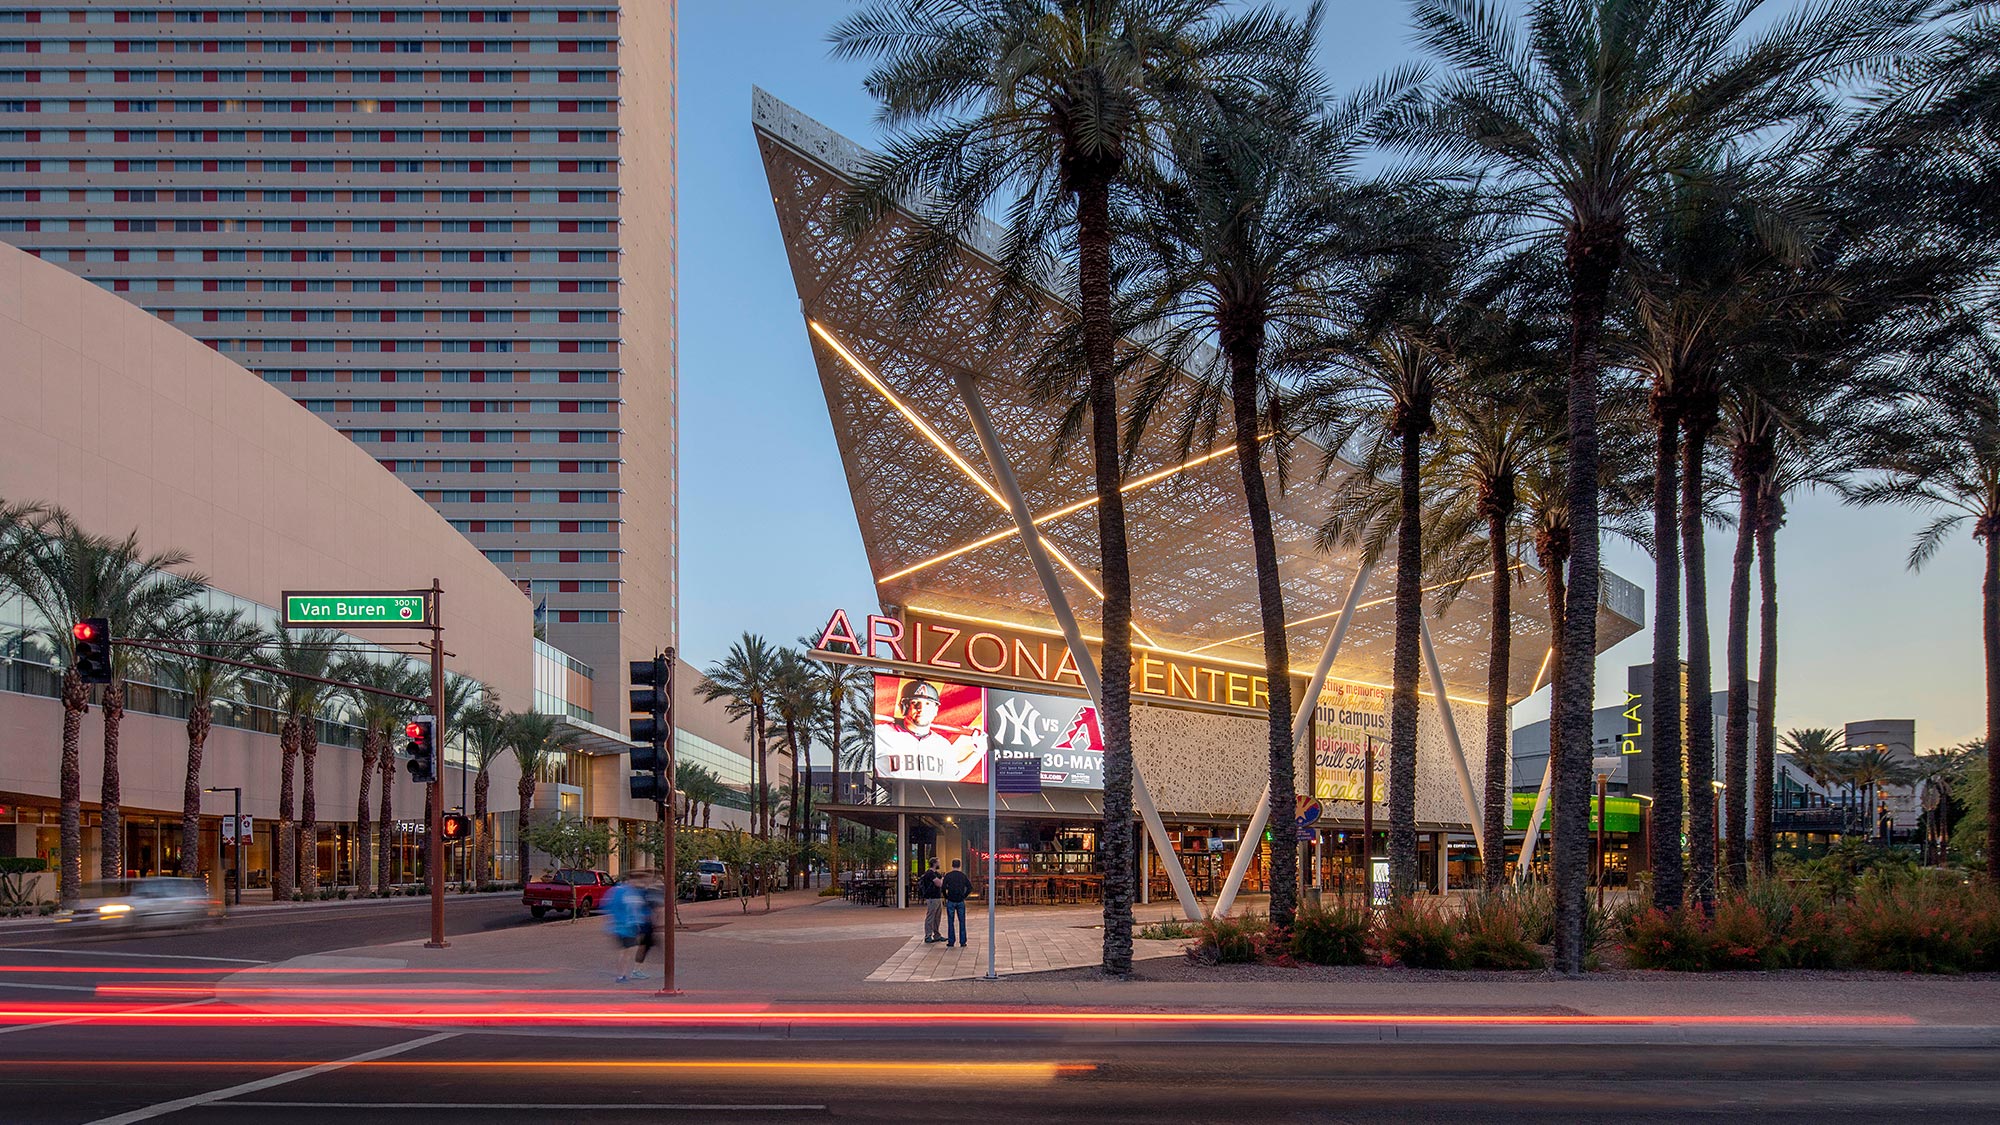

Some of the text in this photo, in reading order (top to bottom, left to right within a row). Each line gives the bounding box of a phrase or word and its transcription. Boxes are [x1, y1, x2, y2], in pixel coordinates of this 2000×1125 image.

[300, 602, 386, 616] Van Buren
[816, 608, 1269, 707] ARIZONA ENTER
[1322, 679, 1385, 699] sting memories
[1318, 695, 1347, 710] amily
[1042, 718, 1059, 732] VS
[1315, 702, 1385, 731] hip campus
[1622, 690, 1642, 754] PLAY
[1316, 723, 1361, 744] meeting
[1316, 736, 1385, 758] delicious fod
[1315, 746, 1385, 777] chill spaes
[1316, 768, 1385, 785] stunning vws
[1316, 772, 1385, 801] local ets
